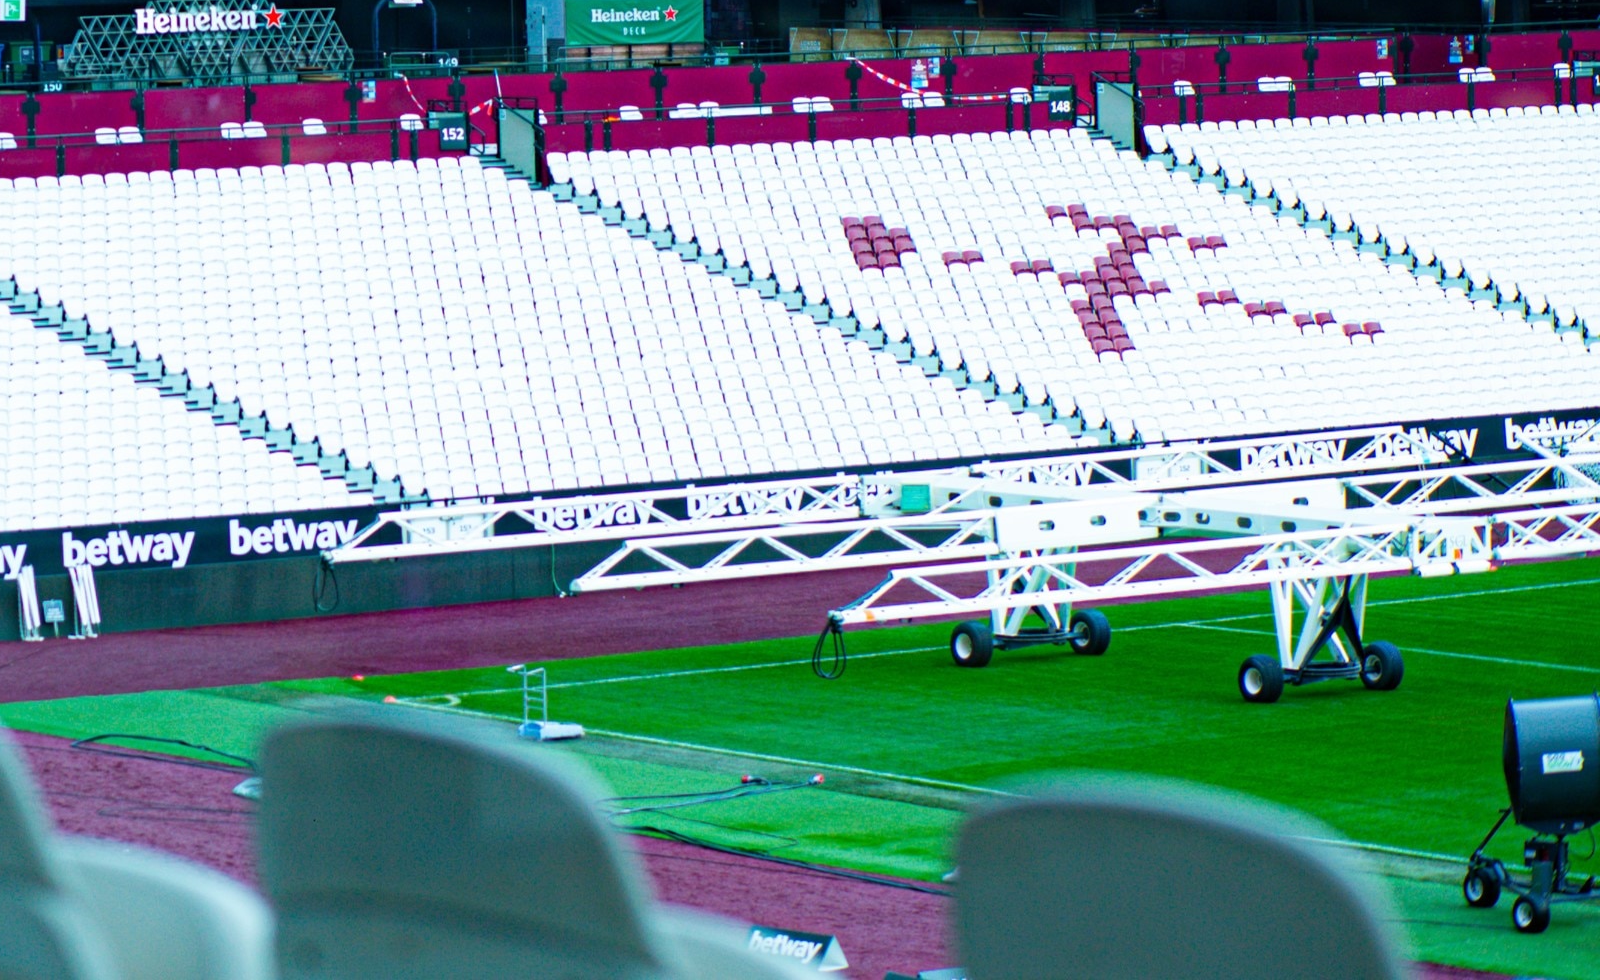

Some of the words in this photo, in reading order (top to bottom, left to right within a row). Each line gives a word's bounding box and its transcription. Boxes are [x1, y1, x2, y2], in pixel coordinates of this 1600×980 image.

[134, 4, 258, 35] Heineken
[591, 7, 660, 23] Heineken
[623, 26, 646, 36] DECK
[1050, 100, 1071, 114] 148
[442, 128, 465, 141] 152
[229, 518, 359, 556] betway
[62, 529, 195, 569] betway
[750, 929, 822, 965] betway
